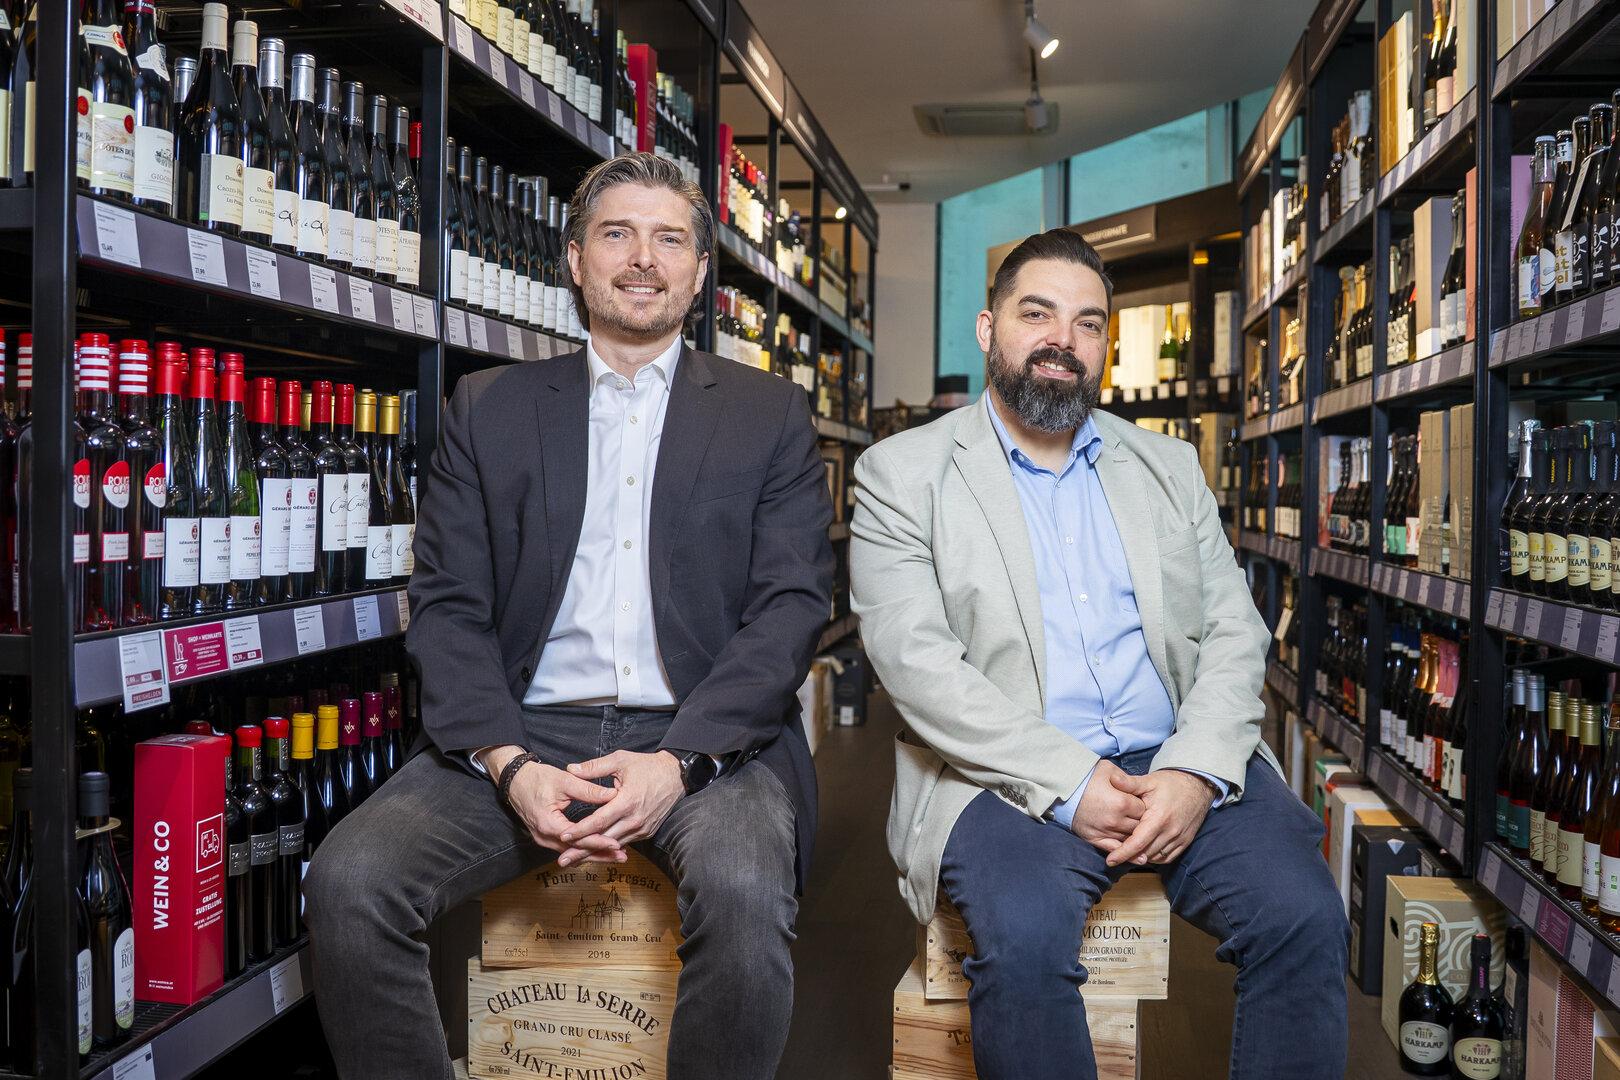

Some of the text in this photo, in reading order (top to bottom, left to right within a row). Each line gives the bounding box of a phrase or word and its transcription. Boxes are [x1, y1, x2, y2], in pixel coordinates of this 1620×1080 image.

[153, 820, 170, 930] WEIN & CO
[536, 866, 662, 893] Tour de Pressac
[1088, 909, 1117, 921] ATEAU
[610, 932, 639, 943] Grand
[645, 931, 662, 943] Cru
[1082, 925, 1142, 940] MOUTON
[588, 950, 611, 960] 2018
[1100, 946, 1122, 956] GRAND
[1123, 946, 1136, 956] CRU
[487, 982, 567, 1015] CHATEAU
[595, 991, 660, 1036] SERRE
[513, 1019, 632, 1044] GRAND CRU CLASSÉ
[1405, 1036, 1444, 1049] HARKAMP
[560, 1046, 582, 1058] 2021
[501, 1040, 647, 1080] SAINT-EMILION
